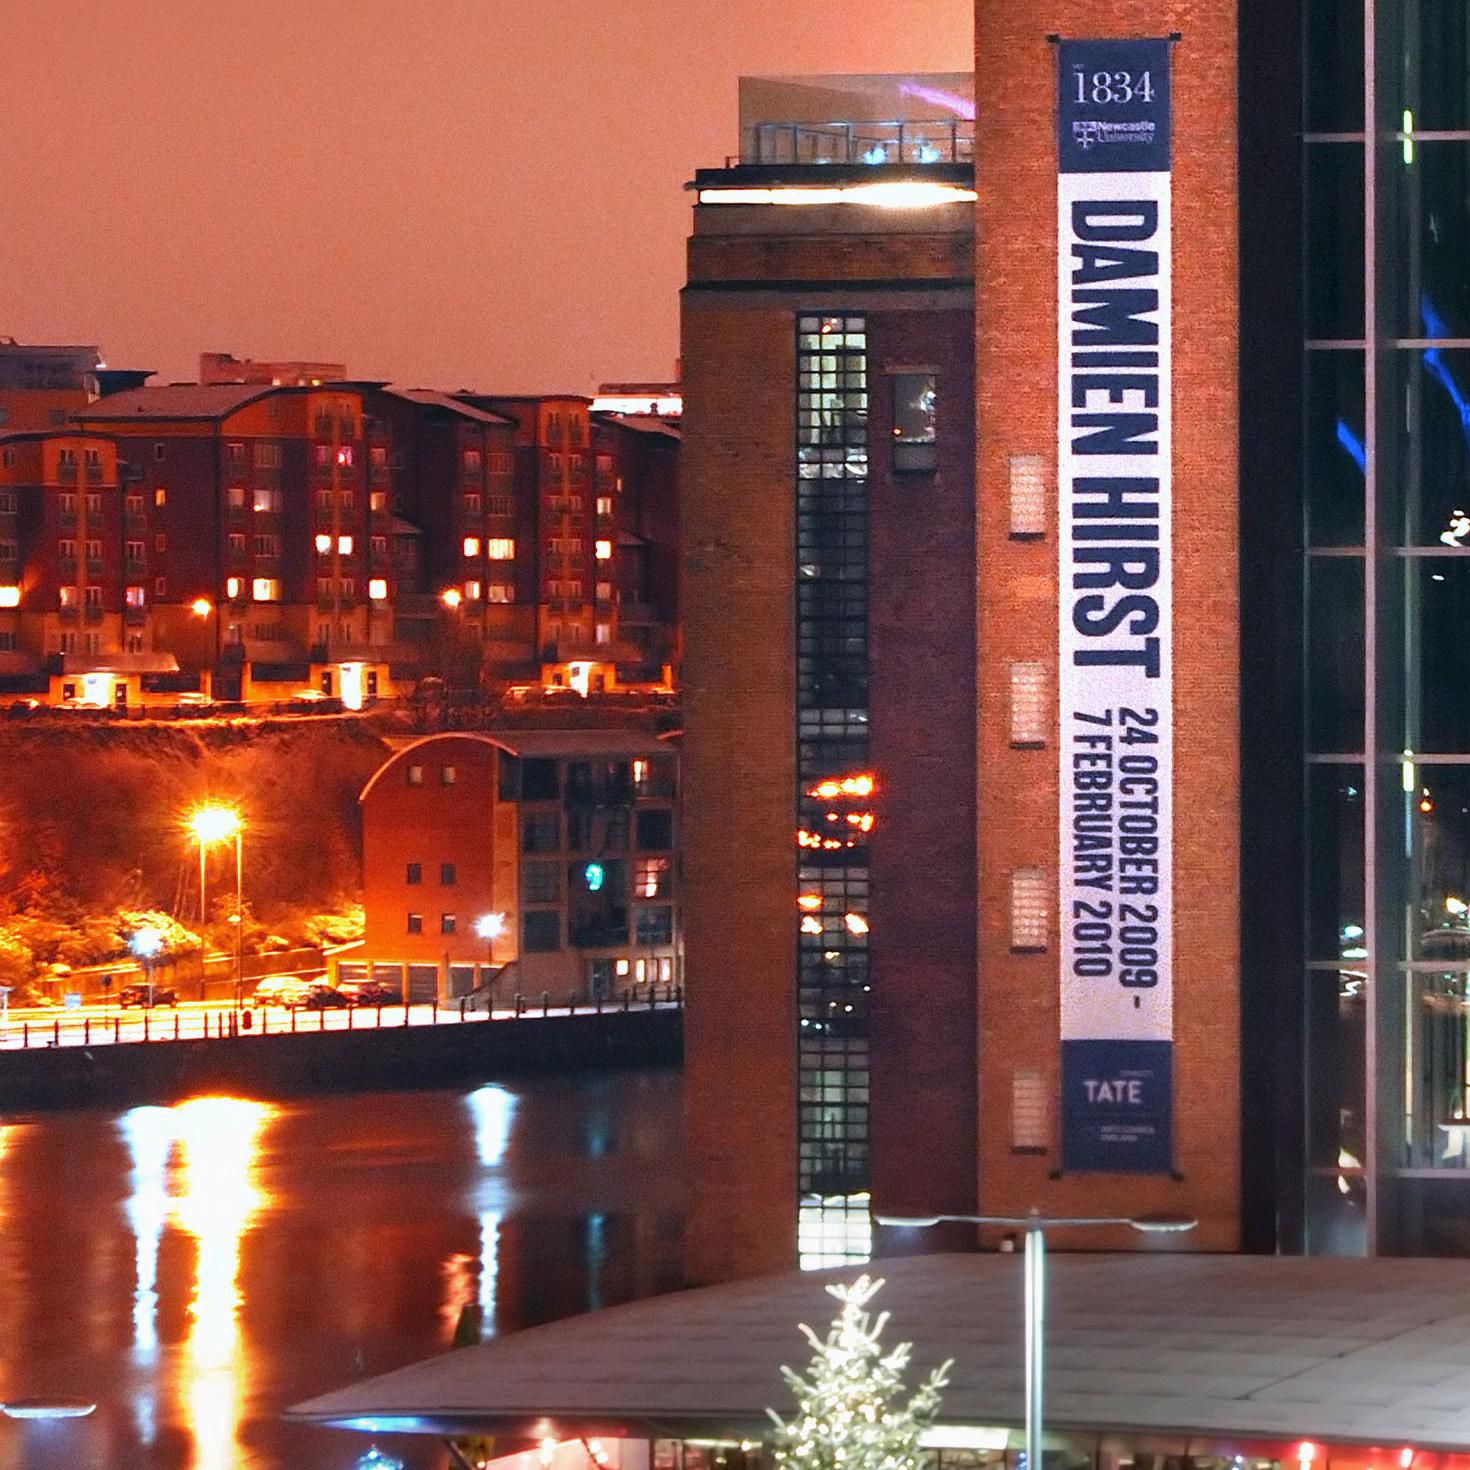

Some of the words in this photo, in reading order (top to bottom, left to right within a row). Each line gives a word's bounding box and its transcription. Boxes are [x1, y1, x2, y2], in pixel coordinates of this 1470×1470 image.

[1073, 71, 1155, 103] 1834
[1071, 200, 1159, 455] DAMIEN
[1072, 477, 1161, 678] HIRST
[1073, 709, 1112, 727] 7
[1119, 707, 1159, 743] 24
[1073, 735, 1112, 891] FEBRUARY
[1119, 755, 1159, 895] OCTOBER
[1073, 900, 1112, 977] 2010
[1119, 904, 1159, 987] 2009
[1084, 1080, 1142, 1103] TATE
